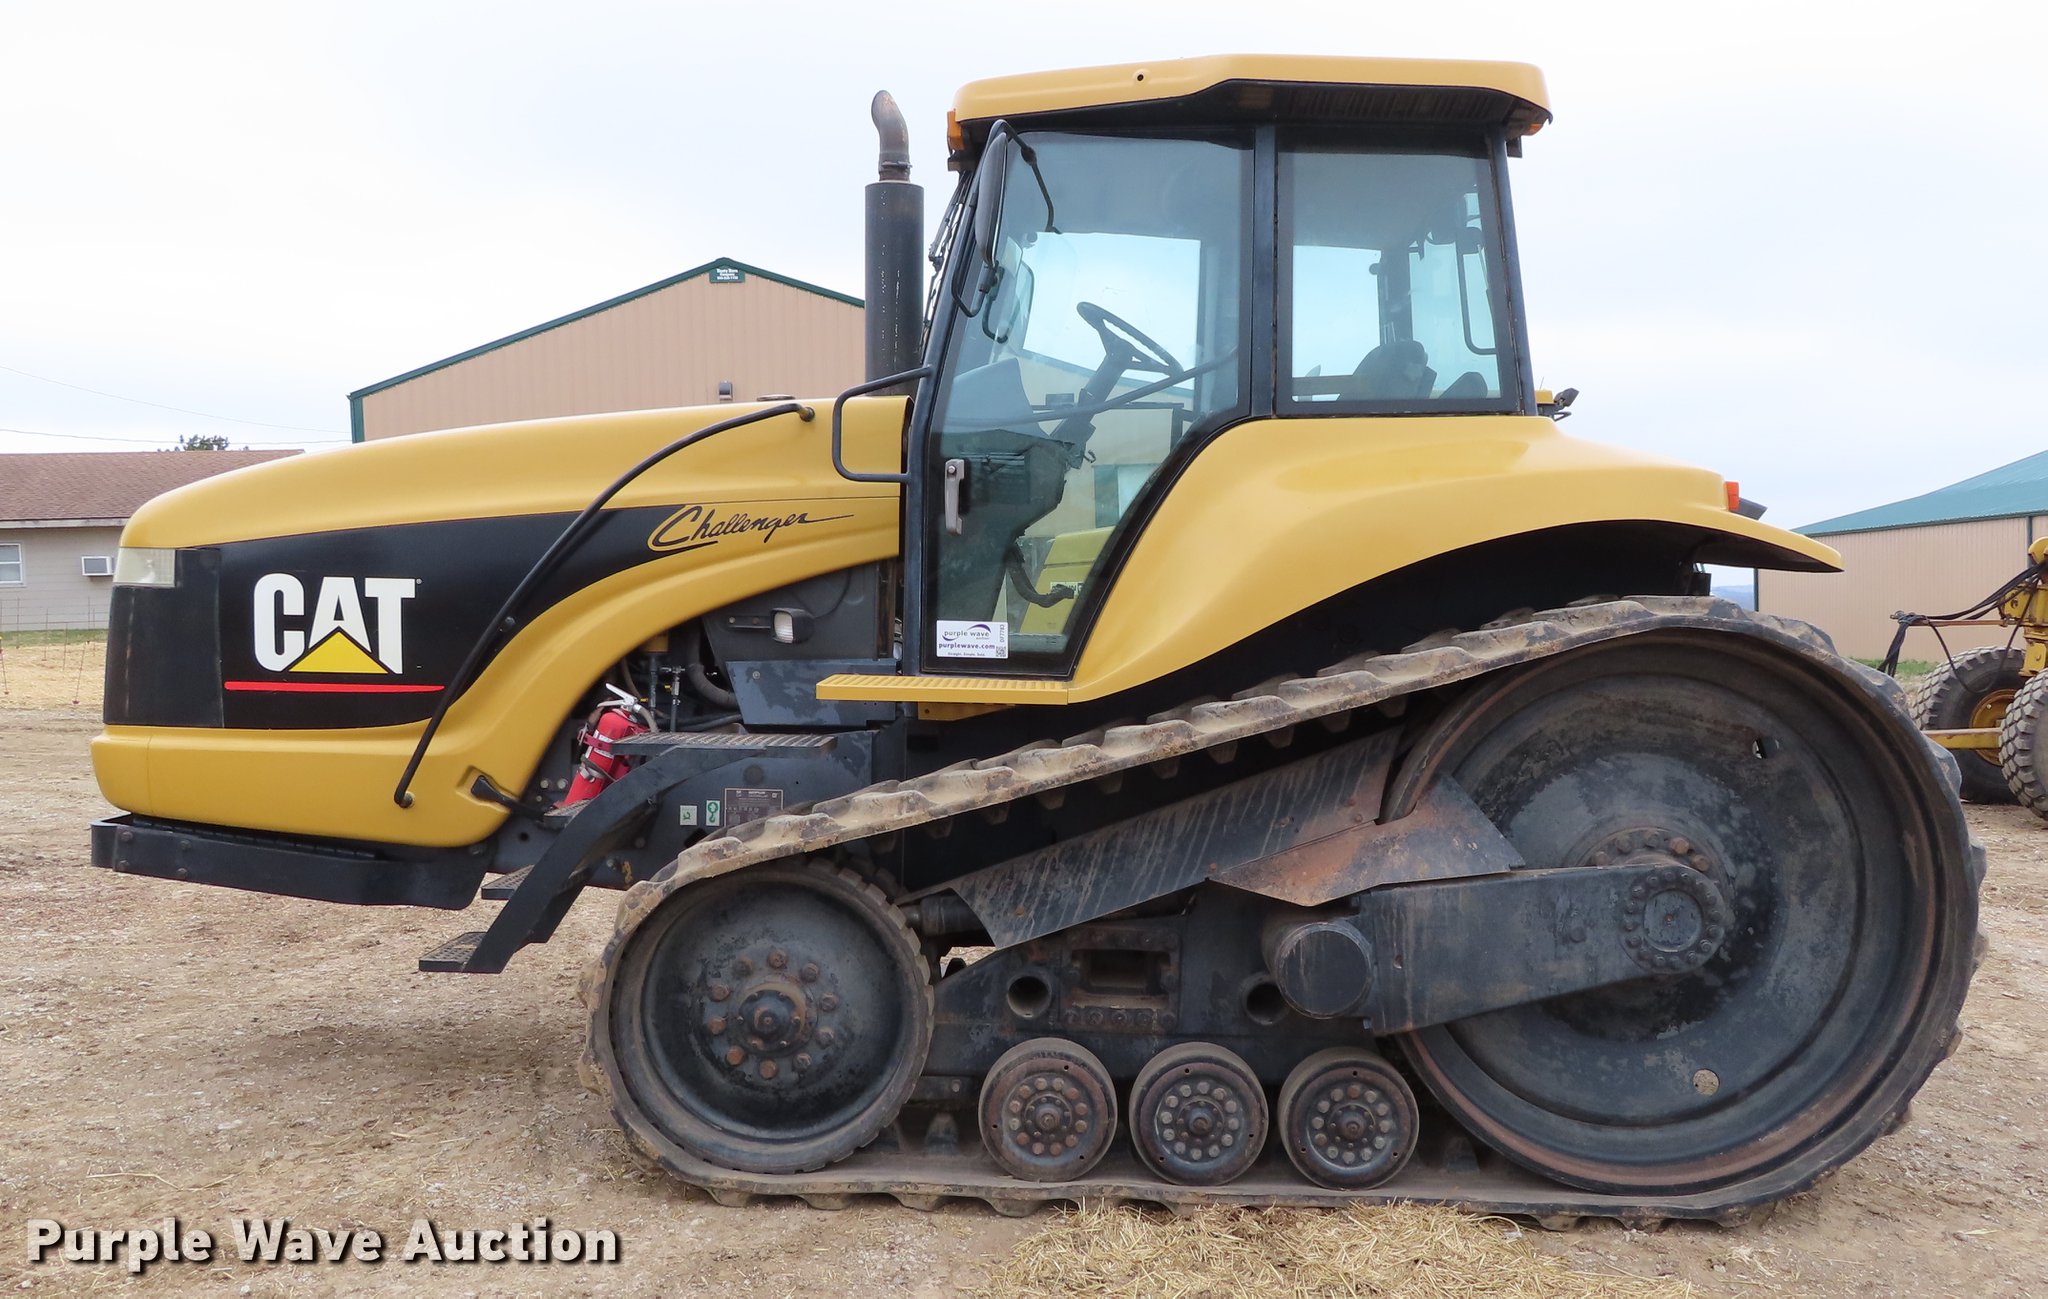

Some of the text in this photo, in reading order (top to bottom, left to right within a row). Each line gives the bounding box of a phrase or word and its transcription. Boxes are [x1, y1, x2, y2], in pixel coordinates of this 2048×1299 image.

[652, 505, 854, 544] Challenger
[254, 573, 416, 674] CAT
[938, 642, 995, 650] purplewave.com
